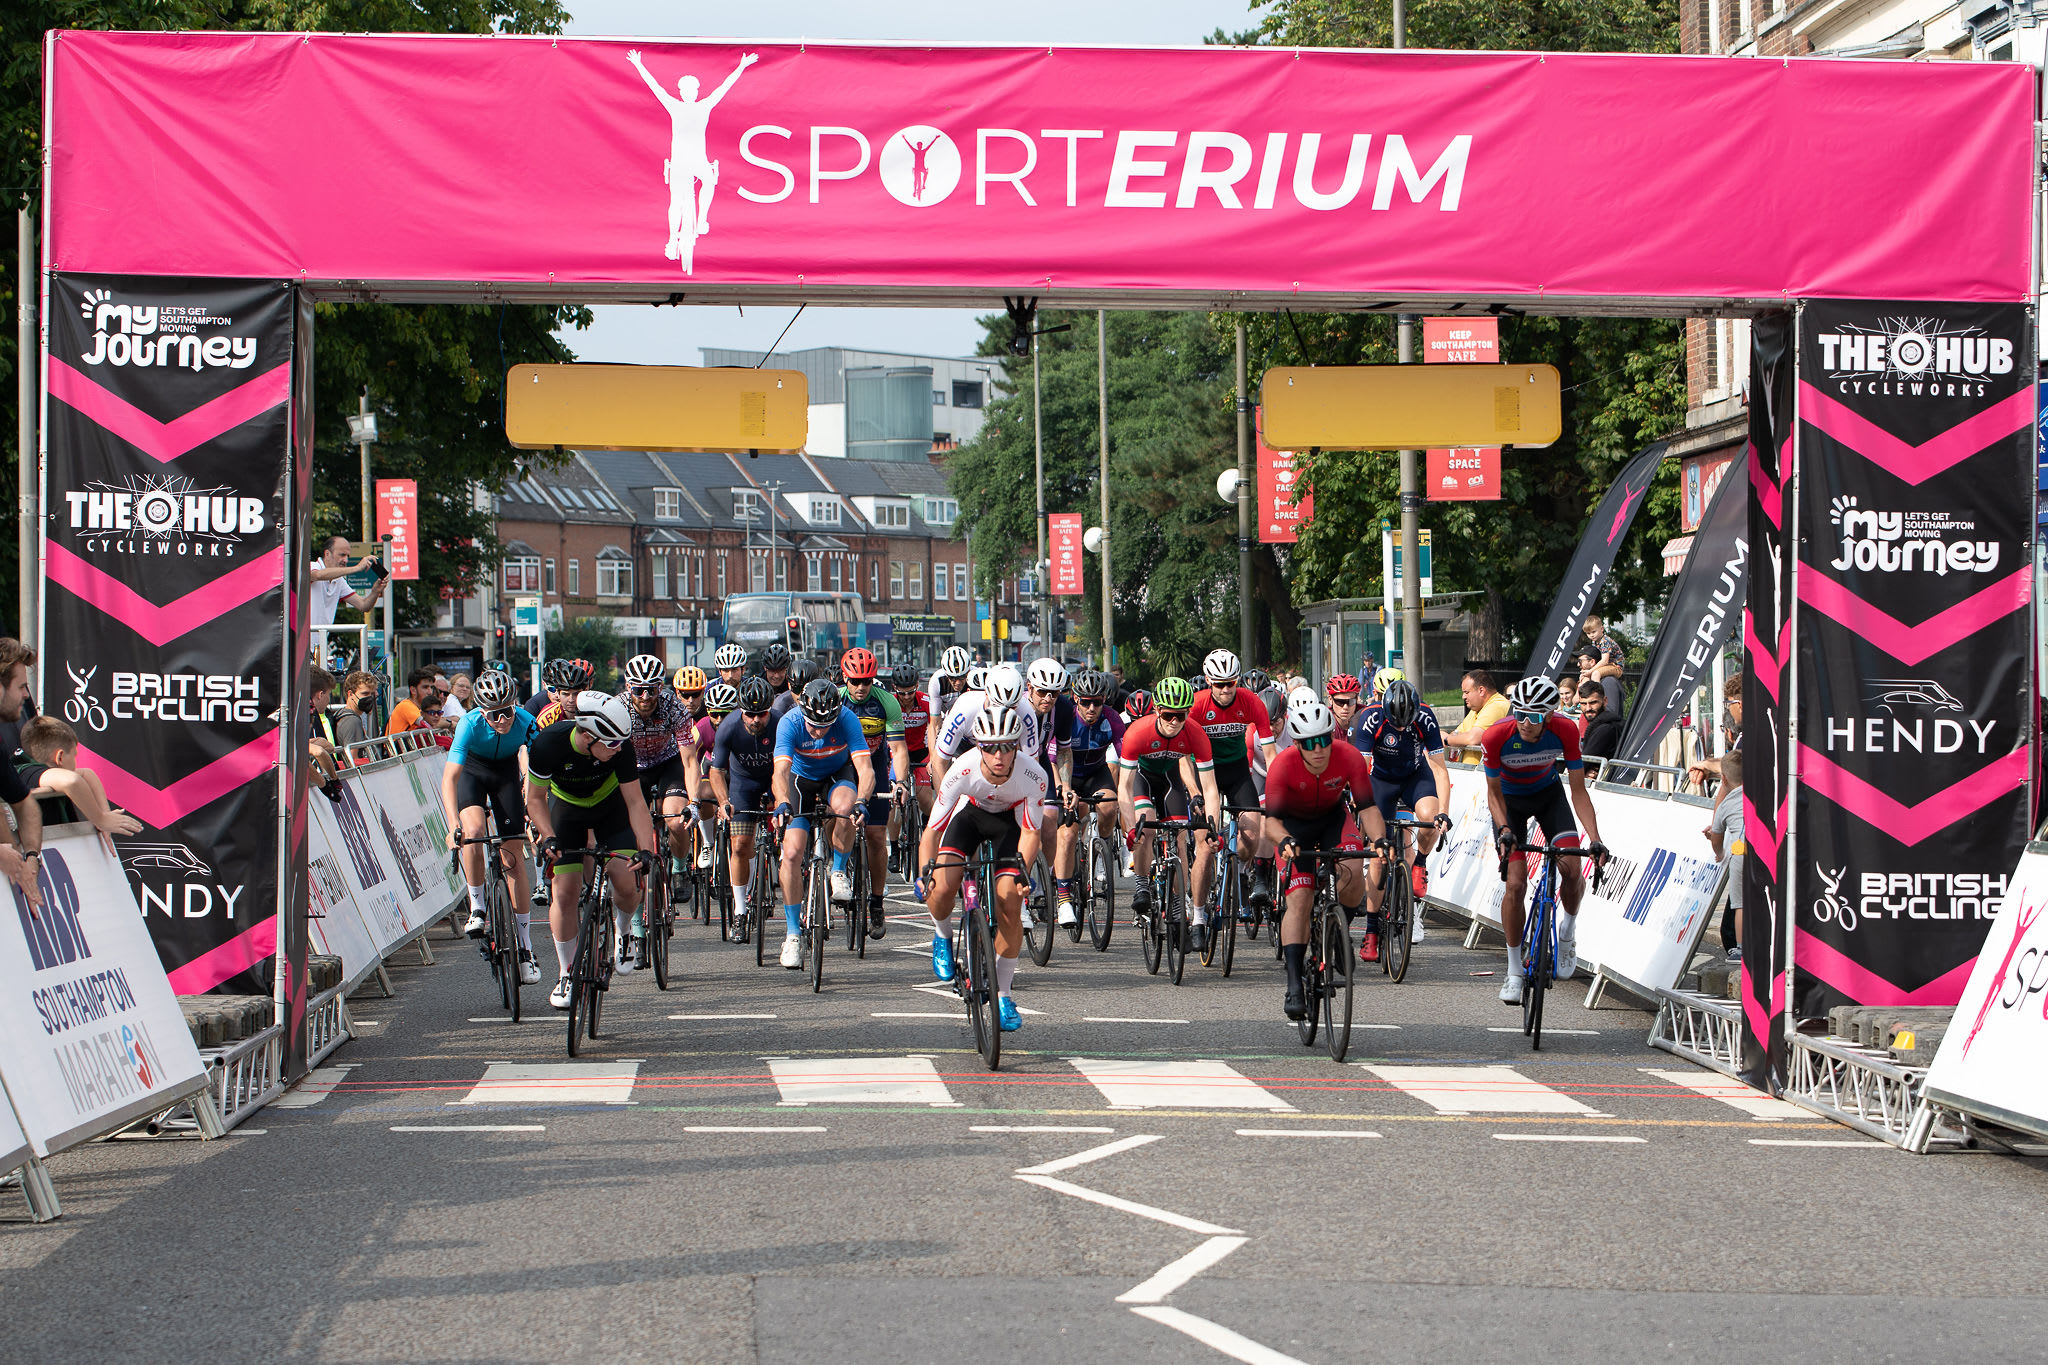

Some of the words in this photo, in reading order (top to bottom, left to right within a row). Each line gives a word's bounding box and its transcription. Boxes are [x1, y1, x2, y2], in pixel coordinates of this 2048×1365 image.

[737, 124, 1473, 212] SPORTERIUM
[160, 307, 184, 316] LET'S
[187, 307, 207, 316] GET
[160, 315, 231, 326] SOUTHAMPTON
[160, 324, 197, 334] MOVING
[1449, 330, 1472, 340] KEEP
[1431, 340, 1493, 350] SOUTHAMPTON
[1447, 350, 1477, 362] SAFE
[1818, 334, 1886, 373] THE
[1936, 337, 2014, 375] HUB
[1840, 380, 1985, 397] CYCLEWORKS
[1448, 458, 1481, 469] SPACE
[1276, 484, 1296, 492] FAC
[66, 491, 132, 530] THE
[183, 496, 265, 534] HUB
[1274, 511, 1299, 520] SPACE
[1905, 512, 1928, 521] LET'S
[1931, 512, 1950, 521] GET
[1905, 520, 1975, 531] SOUTHAMPTON
[1905, 529, 1941, 539] MOVING
[87, 539, 234, 557] CYCLEWORKS
[900, 619, 924, 631] Moores
[112, 672, 260, 699] BRITISH
[111, 697, 260, 723] CYCLING
[1827, 717, 1997, 754] HENDY
[1023, 768, 1042, 784] HSBC
[1861, 872, 2008, 897] BRITISH
[129, 884, 244, 919] NDY
[1860, 896, 2003, 920] CYCLING
[32, 967, 137, 1035] SOUTHAMPTON
